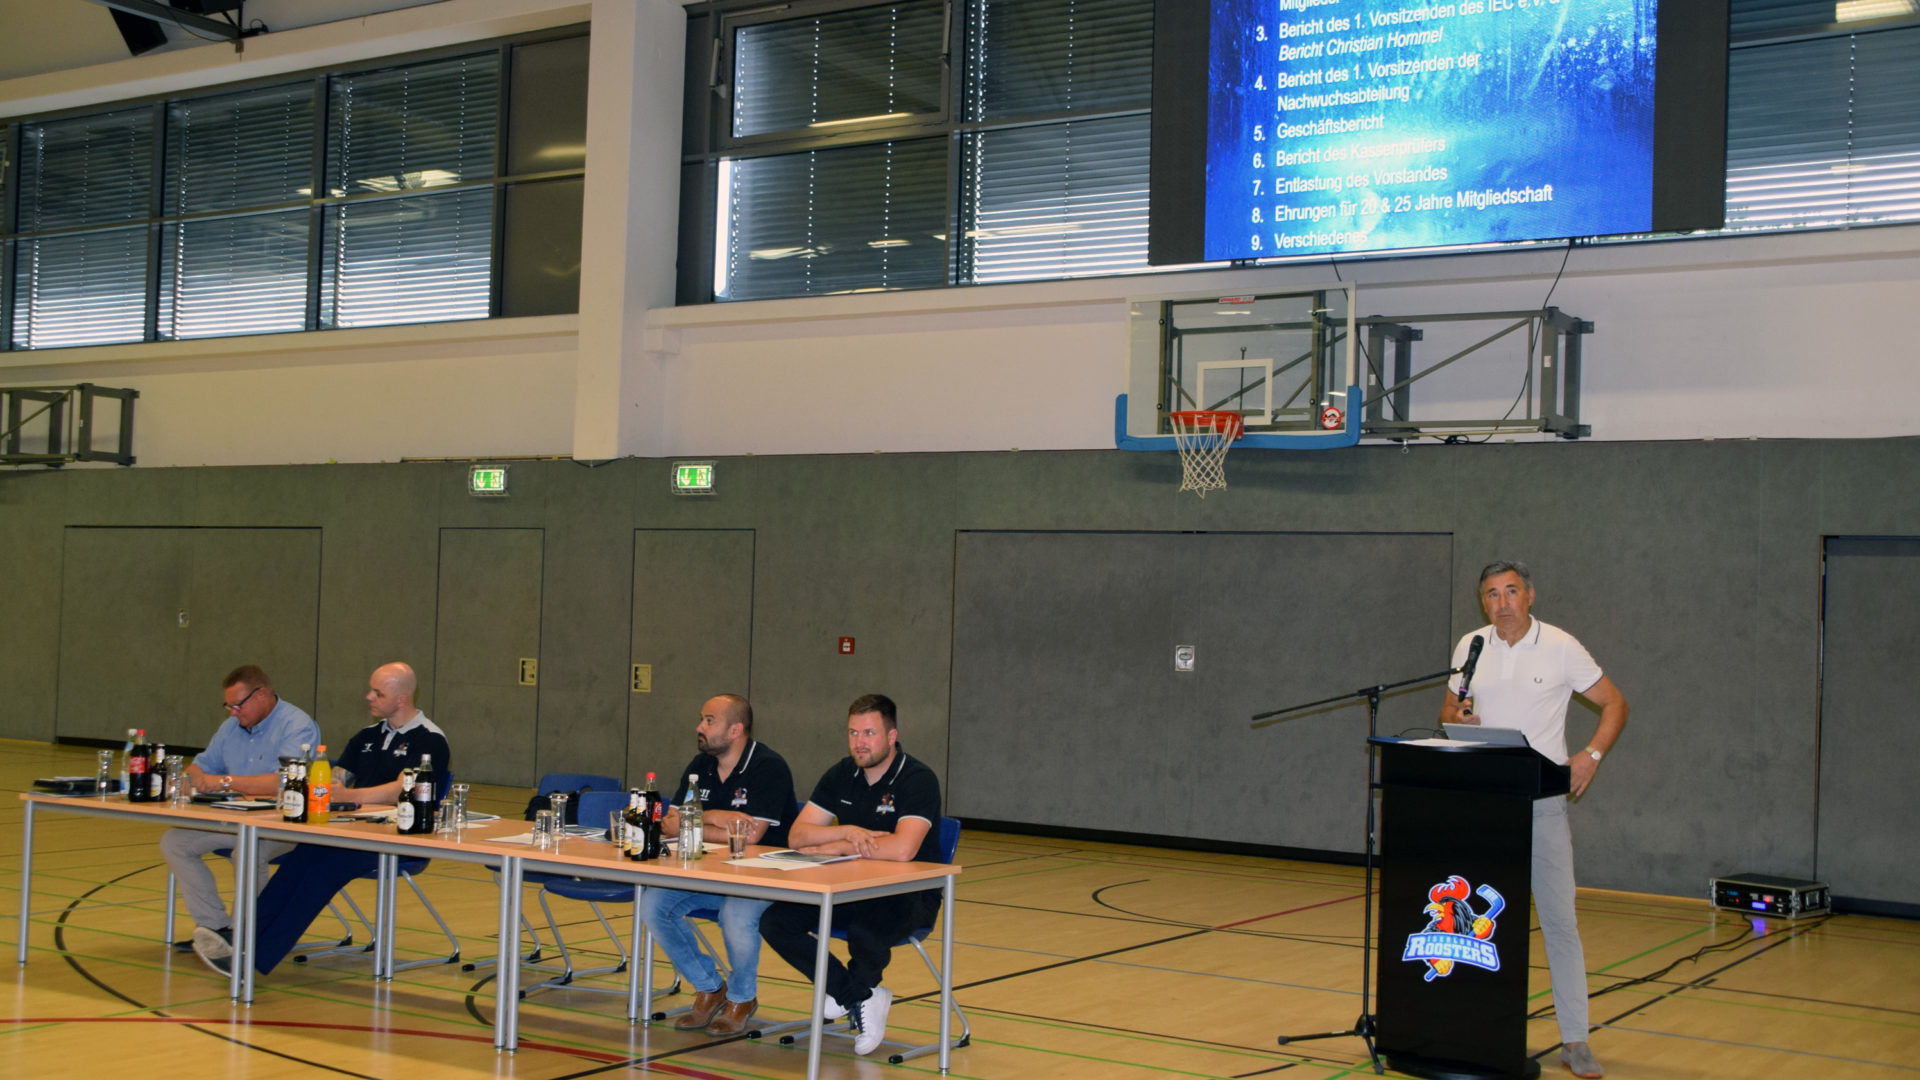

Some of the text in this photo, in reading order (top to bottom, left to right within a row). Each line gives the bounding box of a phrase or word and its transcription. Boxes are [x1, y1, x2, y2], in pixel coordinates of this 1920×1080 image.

[1256, 25, 1268, 41] 3.
[1279, 19, 1324, 39] Bericht
[1326, 17, 1350, 33] des
[1354, 13, 1365, 29] 1.
[1369, 4, 1455, 27] Vorsitzenden
[1459, 1, 1484, 16] des
[1278, 25, 1444, 61] Bericht Christian Hommel
[1254, 52, 1482, 91] 4. Bericht des 1. Vorsitzenden der
[1277, 85, 1410, 112] Nachwuchsabteilung
[1253, 114, 1385, 141] 5. Geschäftsbericht
[1252, 138, 1446, 168] 6. Bericht des Kassenprüfers
[1252, 165, 1448, 196] 7. Entlastung des Vorstandes
[1251, 184, 1553, 223] 8. Ehrungen für 20 & 25 Jahre Mitgliedschaft
[1251, 230, 1368, 251] 9. Verschiedenes
[1407, 936, 1497, 967] ROOSTERS
